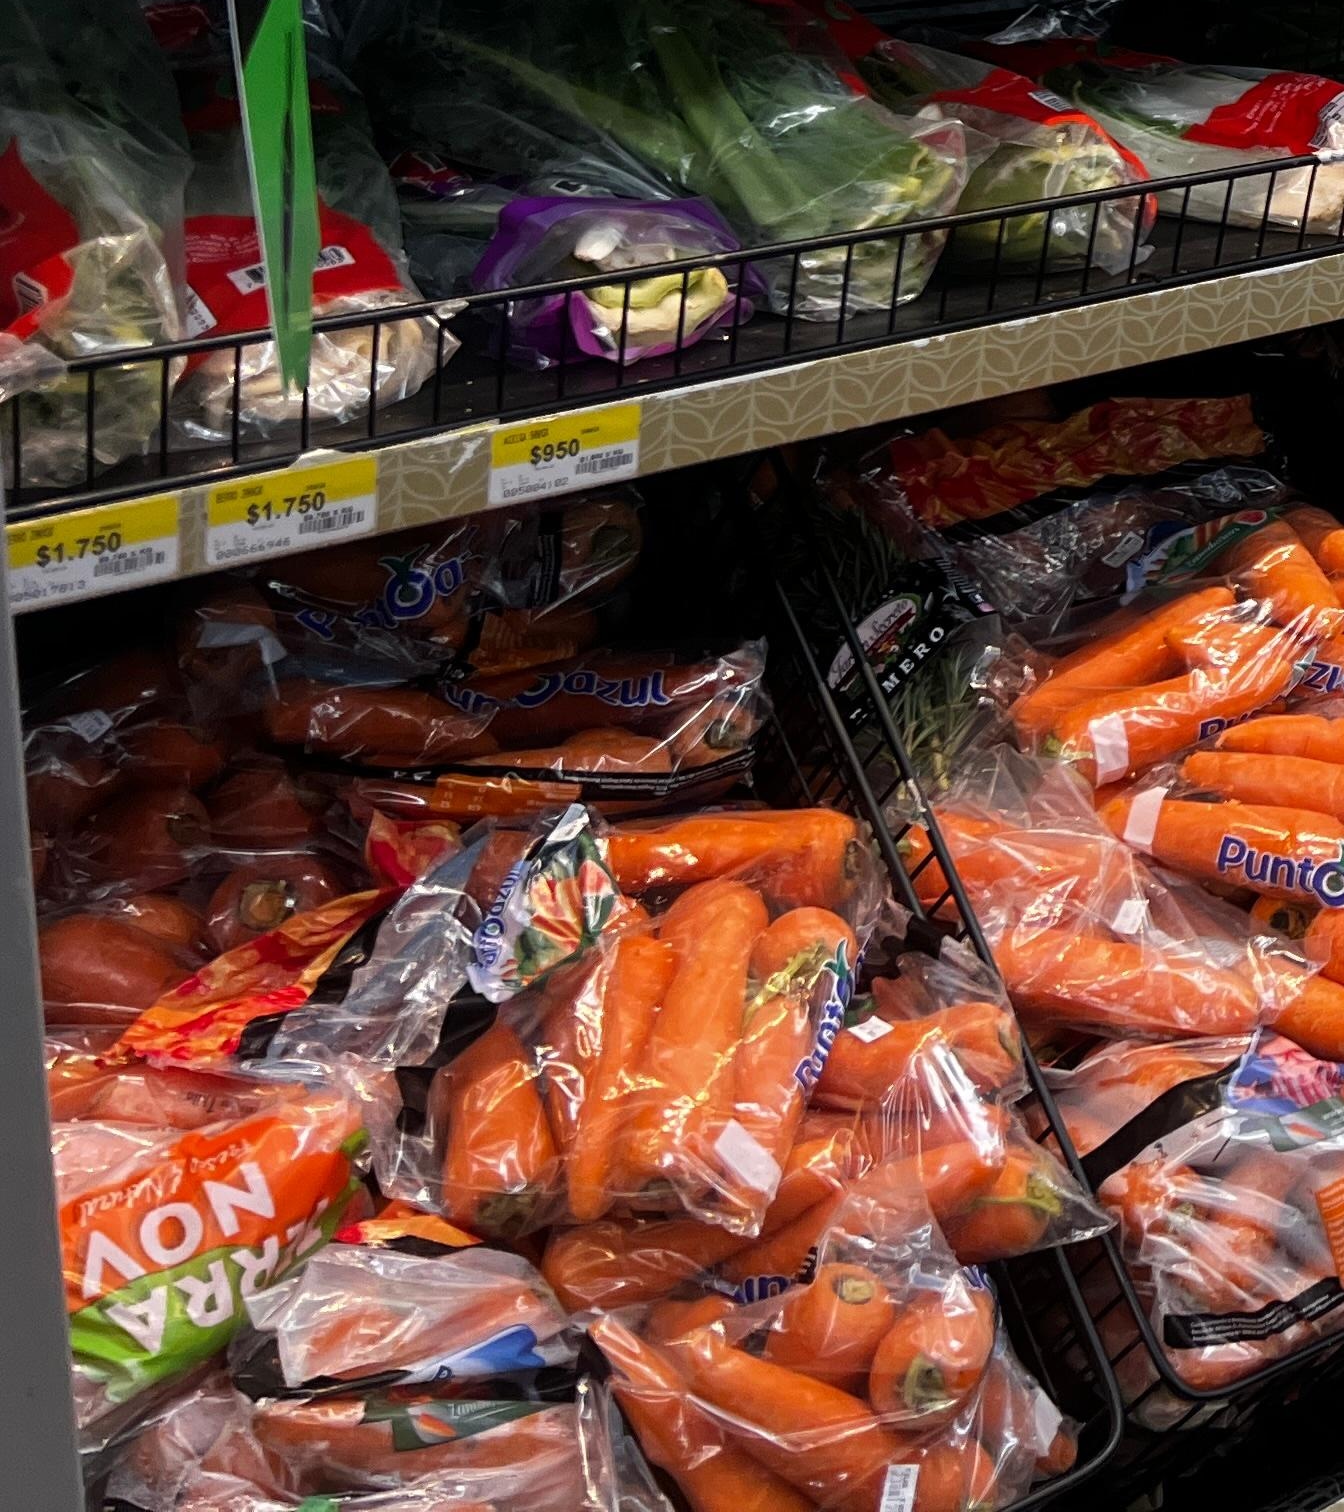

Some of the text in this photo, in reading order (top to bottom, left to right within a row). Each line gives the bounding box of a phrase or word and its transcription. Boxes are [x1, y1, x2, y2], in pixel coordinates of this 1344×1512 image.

[530, 438, 580, 465] $950
[247, 491, 326, 526] $1.750
[36, 531, 122, 568] $1.750
